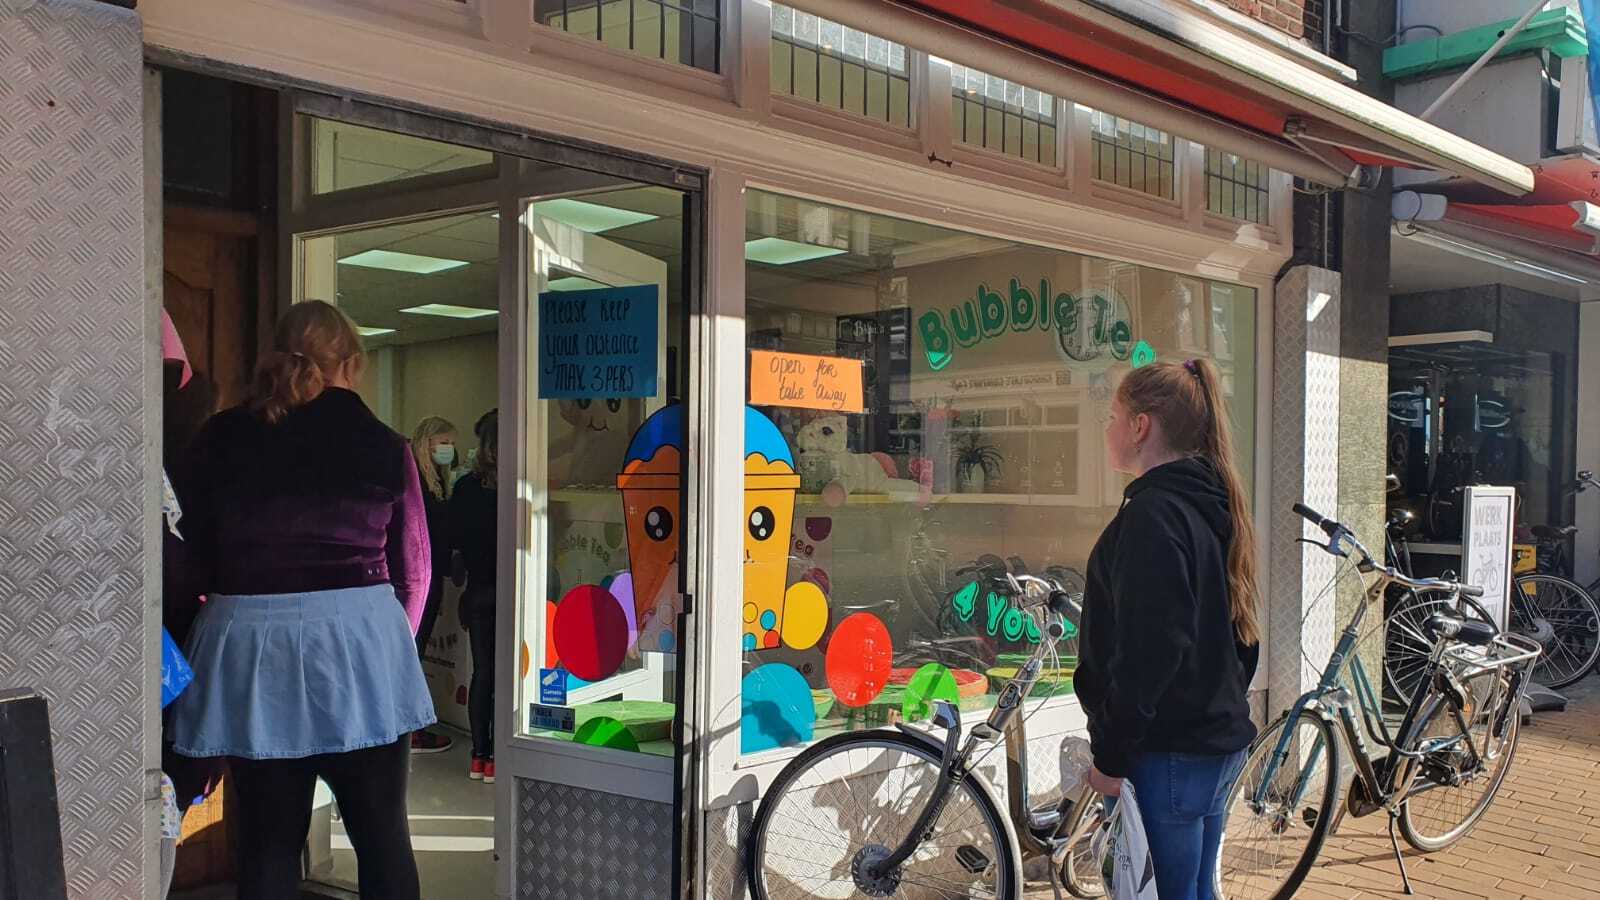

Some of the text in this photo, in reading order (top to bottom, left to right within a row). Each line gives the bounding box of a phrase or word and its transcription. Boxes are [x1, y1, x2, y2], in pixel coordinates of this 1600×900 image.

[545, 298, 587, 324] Please
[917, 276, 1078, 371] Bubble
[554, 363, 585, 391] MAX
[590, 366, 604, 392] 3
[779, 377, 805, 400] take
[1474, 504, 1503, 526] WERK
[1473, 531, 1502, 549] PLAATS
[953, 581, 980, 622] 4
